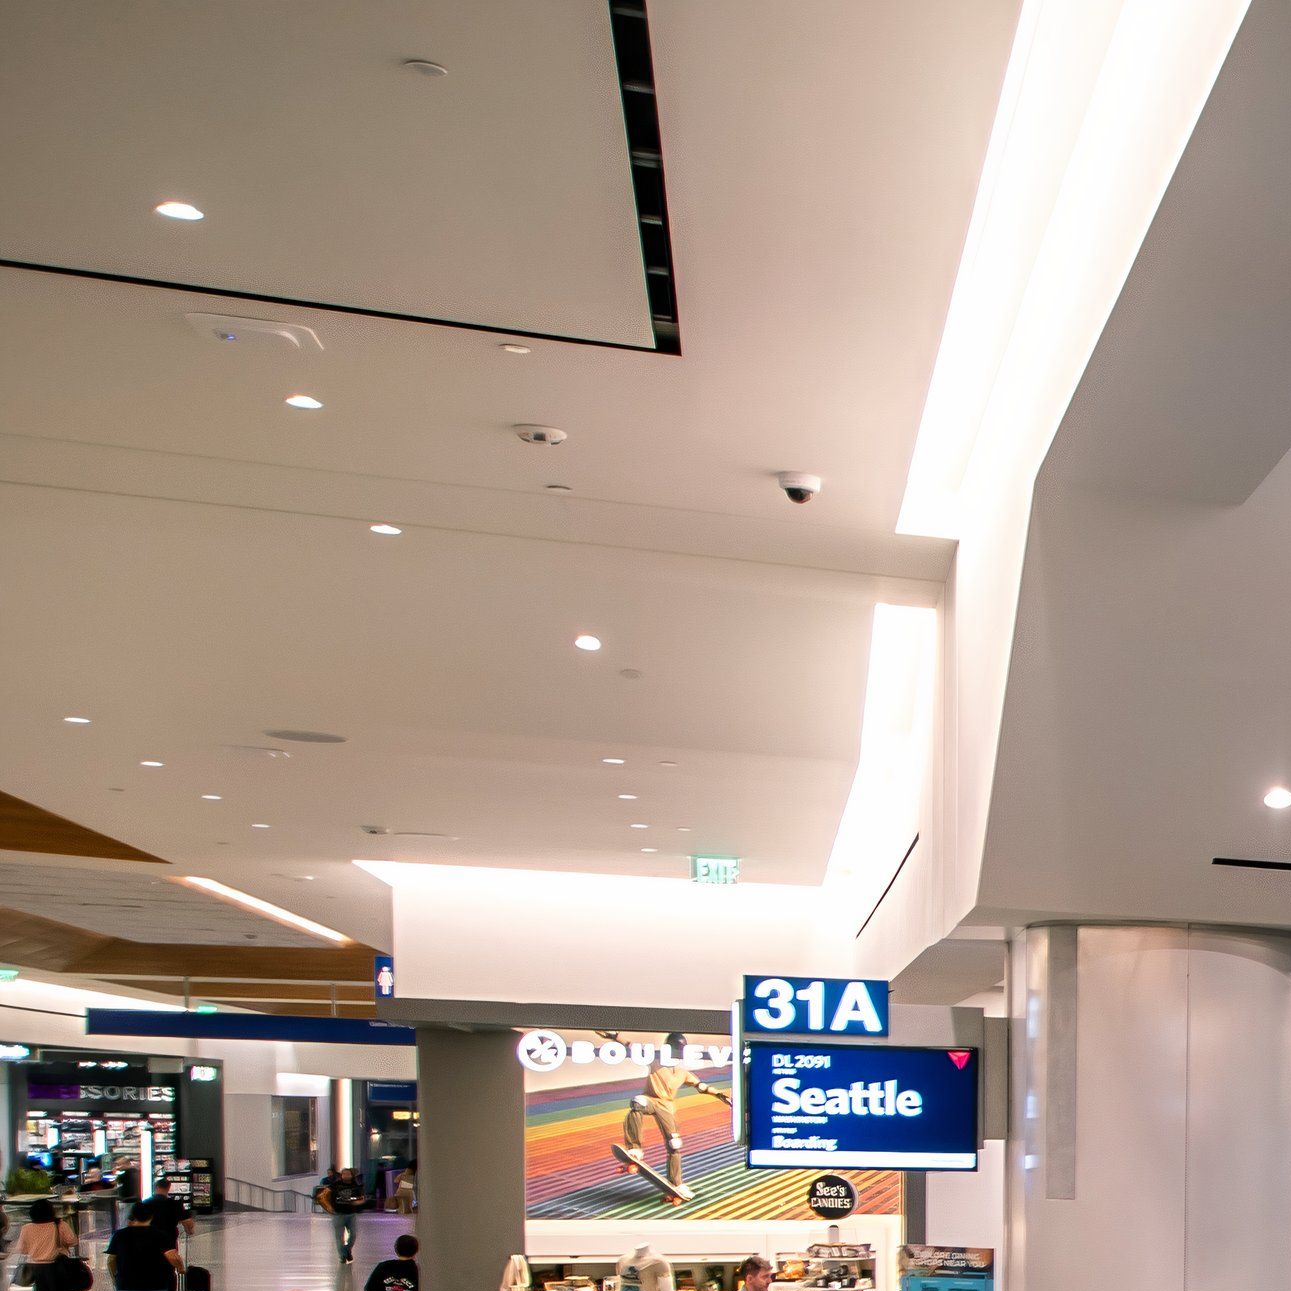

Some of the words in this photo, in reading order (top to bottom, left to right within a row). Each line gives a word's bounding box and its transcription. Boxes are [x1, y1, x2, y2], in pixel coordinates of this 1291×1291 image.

[752, 978, 883, 1032] 31A
[571, 1040, 751, 1067] BOULEV
[771, 1054, 794, 1068] DL
[794, 1055, 831, 1069] 2091
[771, 1077, 923, 1117] Seattle
[816, 1181, 847, 1197] See's
[810, 1197, 851, 1209] CANDIES
